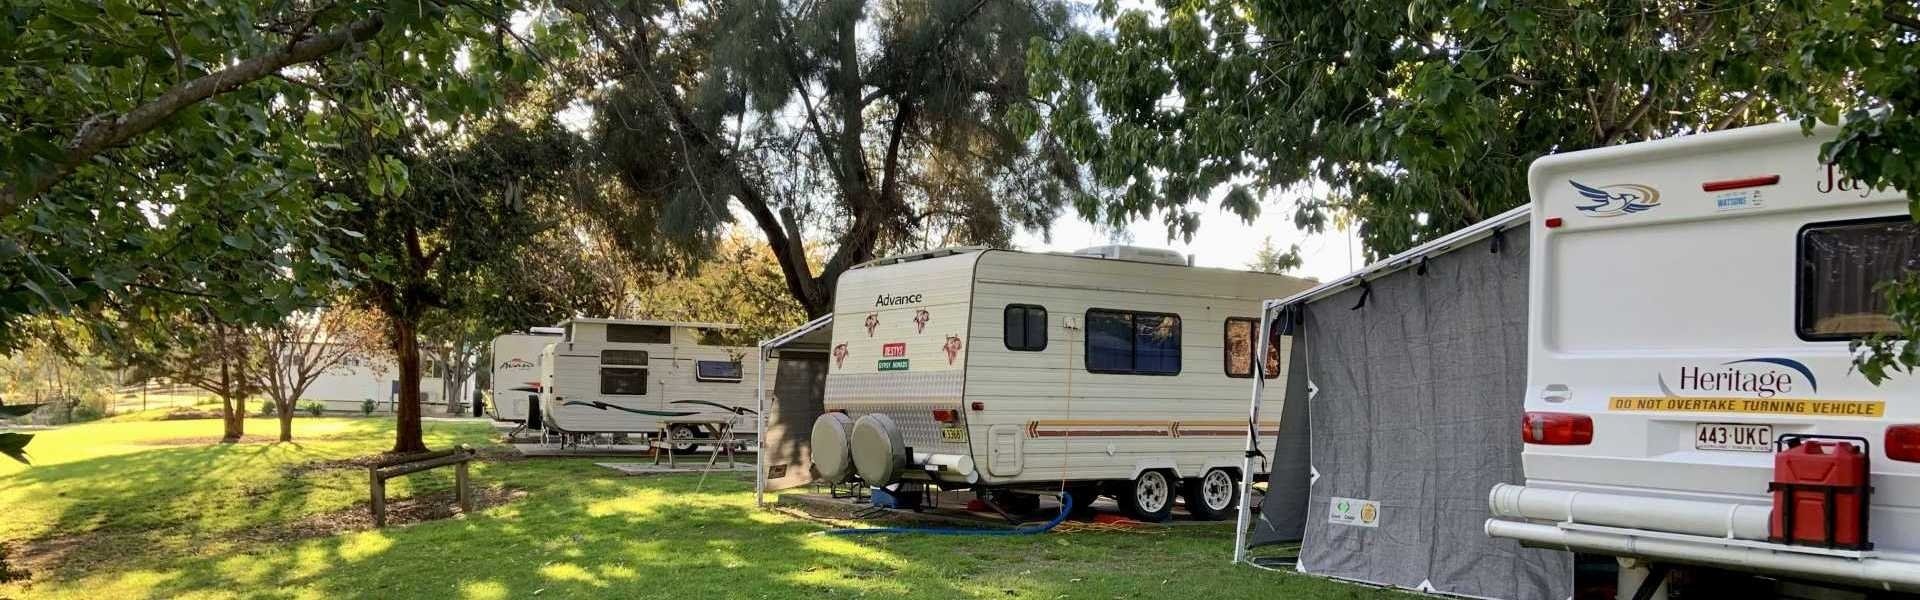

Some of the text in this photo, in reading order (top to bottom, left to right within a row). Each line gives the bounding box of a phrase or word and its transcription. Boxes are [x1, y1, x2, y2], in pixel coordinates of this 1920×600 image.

[875, 293, 922, 307] Advance
[1680, 366, 1792, 398] Heritage
[1615, 399, 1876, 415] DO NOT OVERTAKE TURNING VEHICLE
